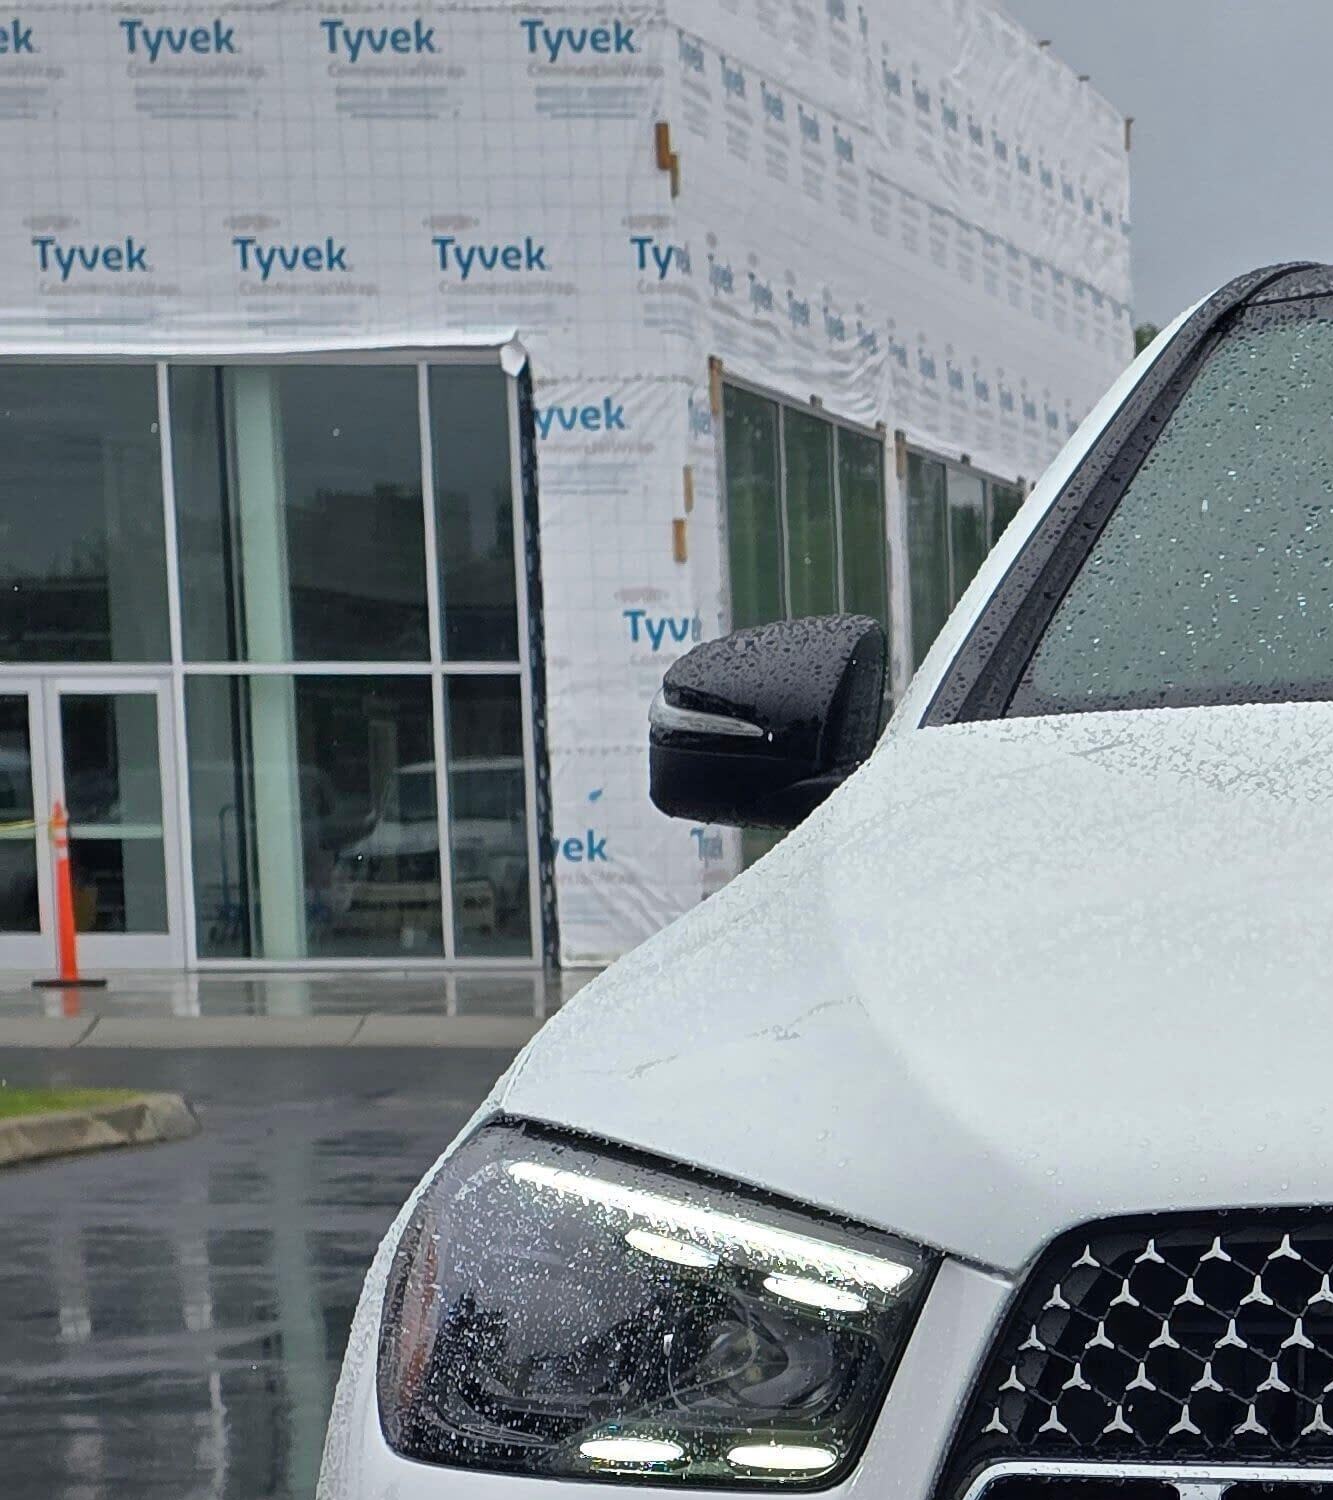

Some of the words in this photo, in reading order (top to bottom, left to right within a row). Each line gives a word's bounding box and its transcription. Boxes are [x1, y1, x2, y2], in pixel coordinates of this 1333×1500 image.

[119, 18, 236, 64] Tyvek
[320, 18, 436, 64] Tyvek
[520, 18, 637, 63] Tyvek
[32, 235, 148, 281] Tyvek
[233, 235, 349, 281] Tyvek
[432, 235, 548, 281] Tyvek
[534, 396, 625, 441] yvek
[622, 606, 702, 652] Tyv
